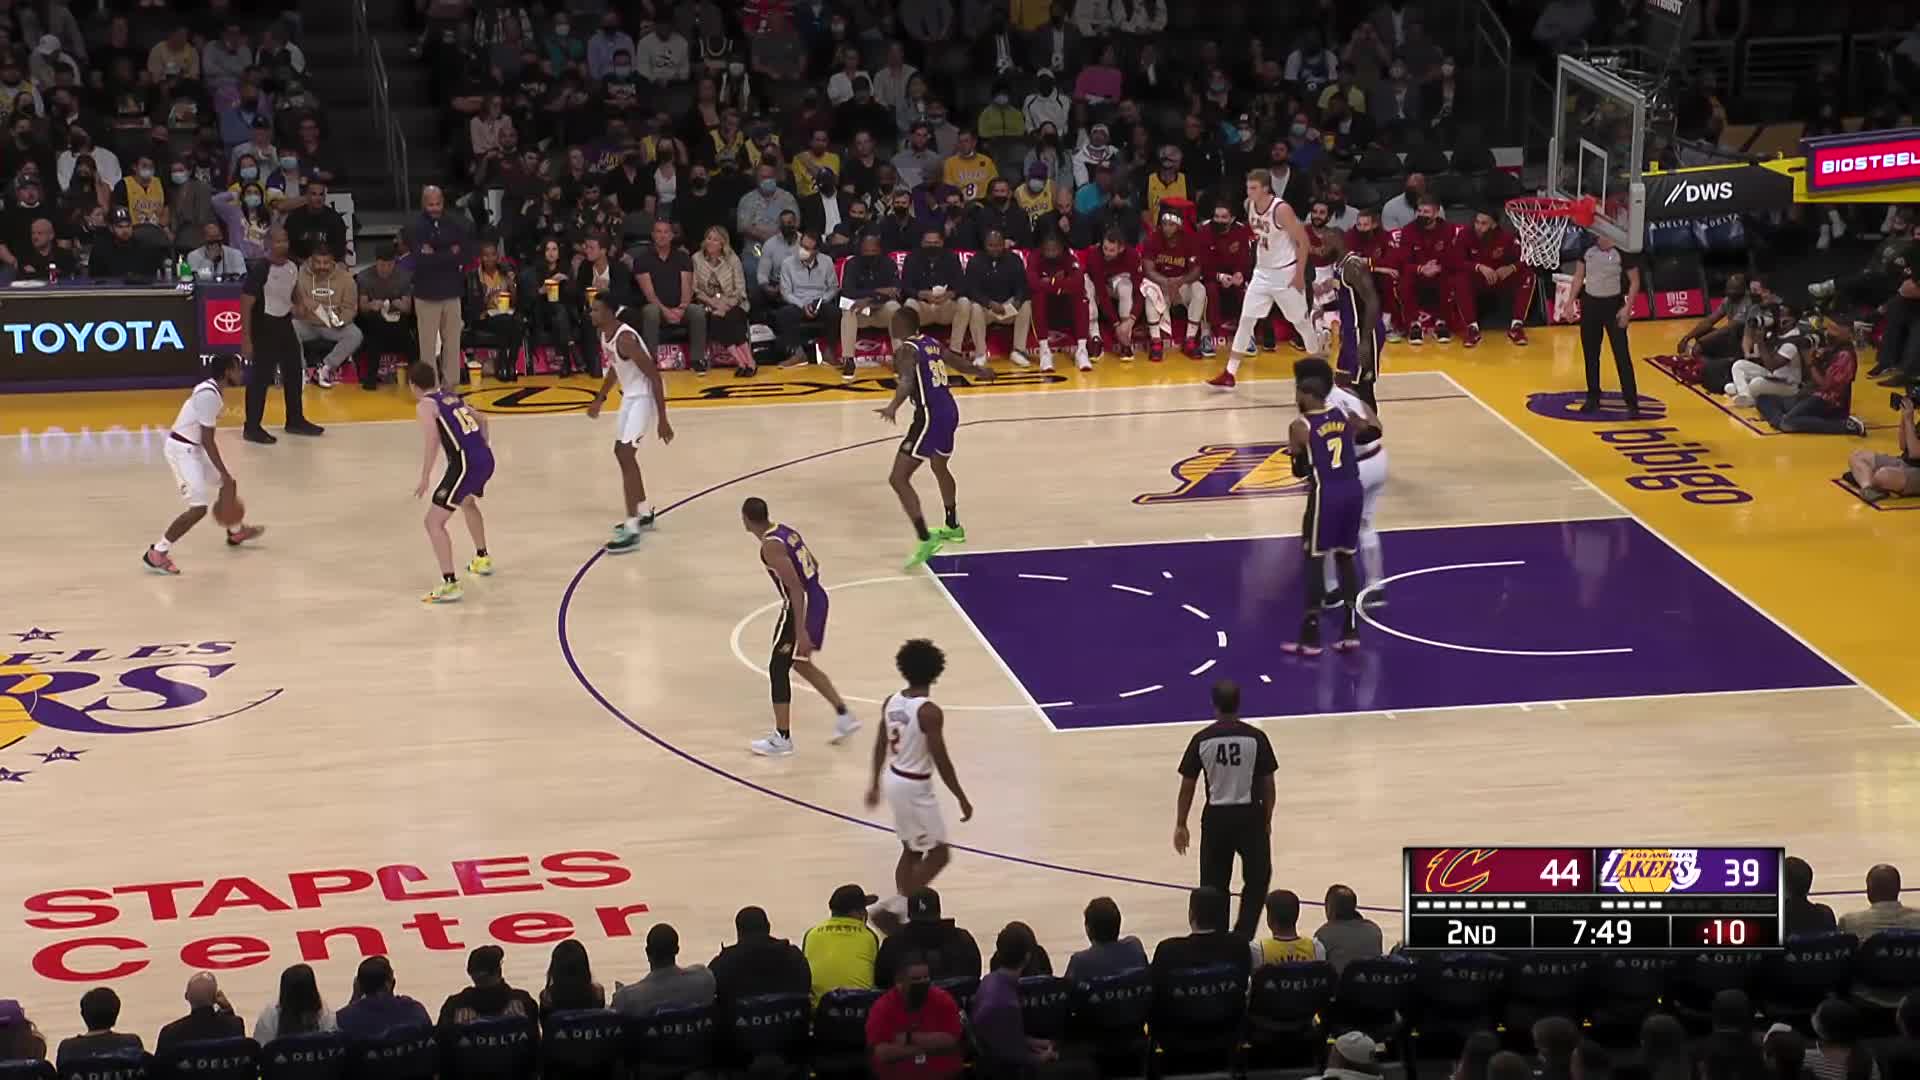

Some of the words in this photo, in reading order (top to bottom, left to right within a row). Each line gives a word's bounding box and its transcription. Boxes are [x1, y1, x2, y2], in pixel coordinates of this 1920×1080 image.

[4, 320, 185, 354] TOYOTA
[1327, 437, 1342, 469] 7
[1593, 427, 1754, 505] bibigo
[1216, 743, 1241, 767] 42
[24, 850, 632, 930] STAPLES
[31, 903, 649, 983] Center
